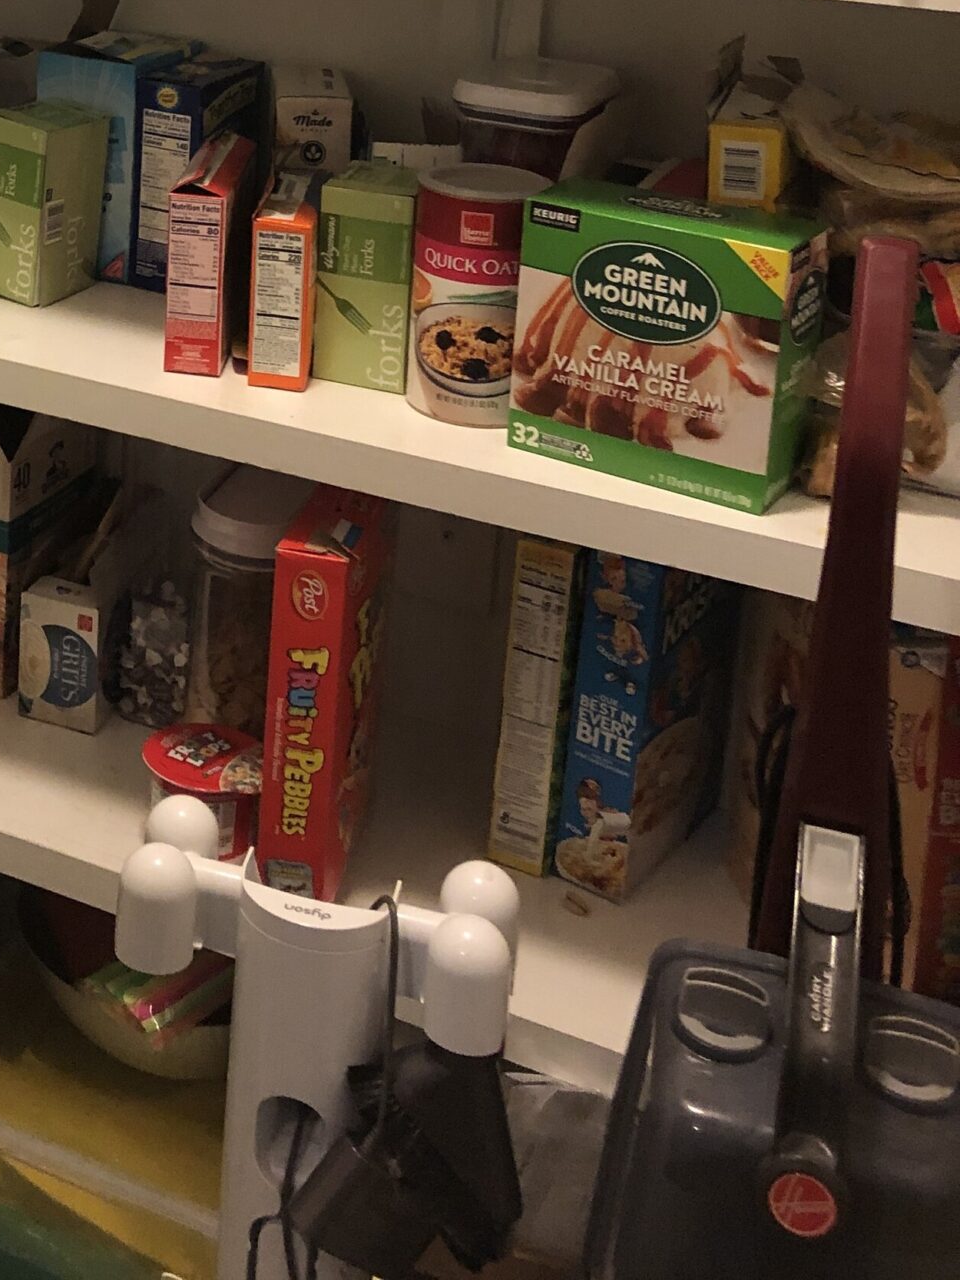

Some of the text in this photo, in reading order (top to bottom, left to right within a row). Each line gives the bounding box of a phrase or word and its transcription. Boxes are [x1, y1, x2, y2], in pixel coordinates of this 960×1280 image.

[144, 110, 191, 123] Nutrition Facts
[293, 113, 333, 127] Made
[5, 164, 17, 197] Forks
[171, 202, 220, 214] Nutrition Facts
[533, 207, 578, 224] KEURIG
[171, 225, 220, 236] Calories 80
[259, 232, 302, 243] Nutrition Facts
[320, 216, 337, 270] Wegmans
[6, 224, 36, 300] forks
[258, 252, 302, 264] Calories 220
[359, 239, 376, 276] Forks
[424, 247, 519, 276] QUICK OAT
[749, 258, 771, 282] PACK
[753, 250, 780, 280] VALUE
[604, 264, 687, 298] GREEN
[584, 279, 708, 323] MOUNTAIN
[600, 305, 687, 332] COFFEE ROASTERS
[366, 304, 405, 390] forks
[588, 345, 690, 384] CARAMEL
[552, 373, 619, 398] ARTIFICIALLY
[620, 389, 680, 414] FLAVORED
[553, 353, 724, 412] VANILLA CREAM
[512, 421, 540, 448] 32
[301, 577, 324, 616] Post
[62, 635, 80, 701] GRITS
[578, 710, 636, 739] EVERY
[579, 694, 637, 727] BEST IN
[575, 723, 633, 762] BITE
[281, 748, 325, 838] PEBBLES
[284, 902, 332, 920] dyson
